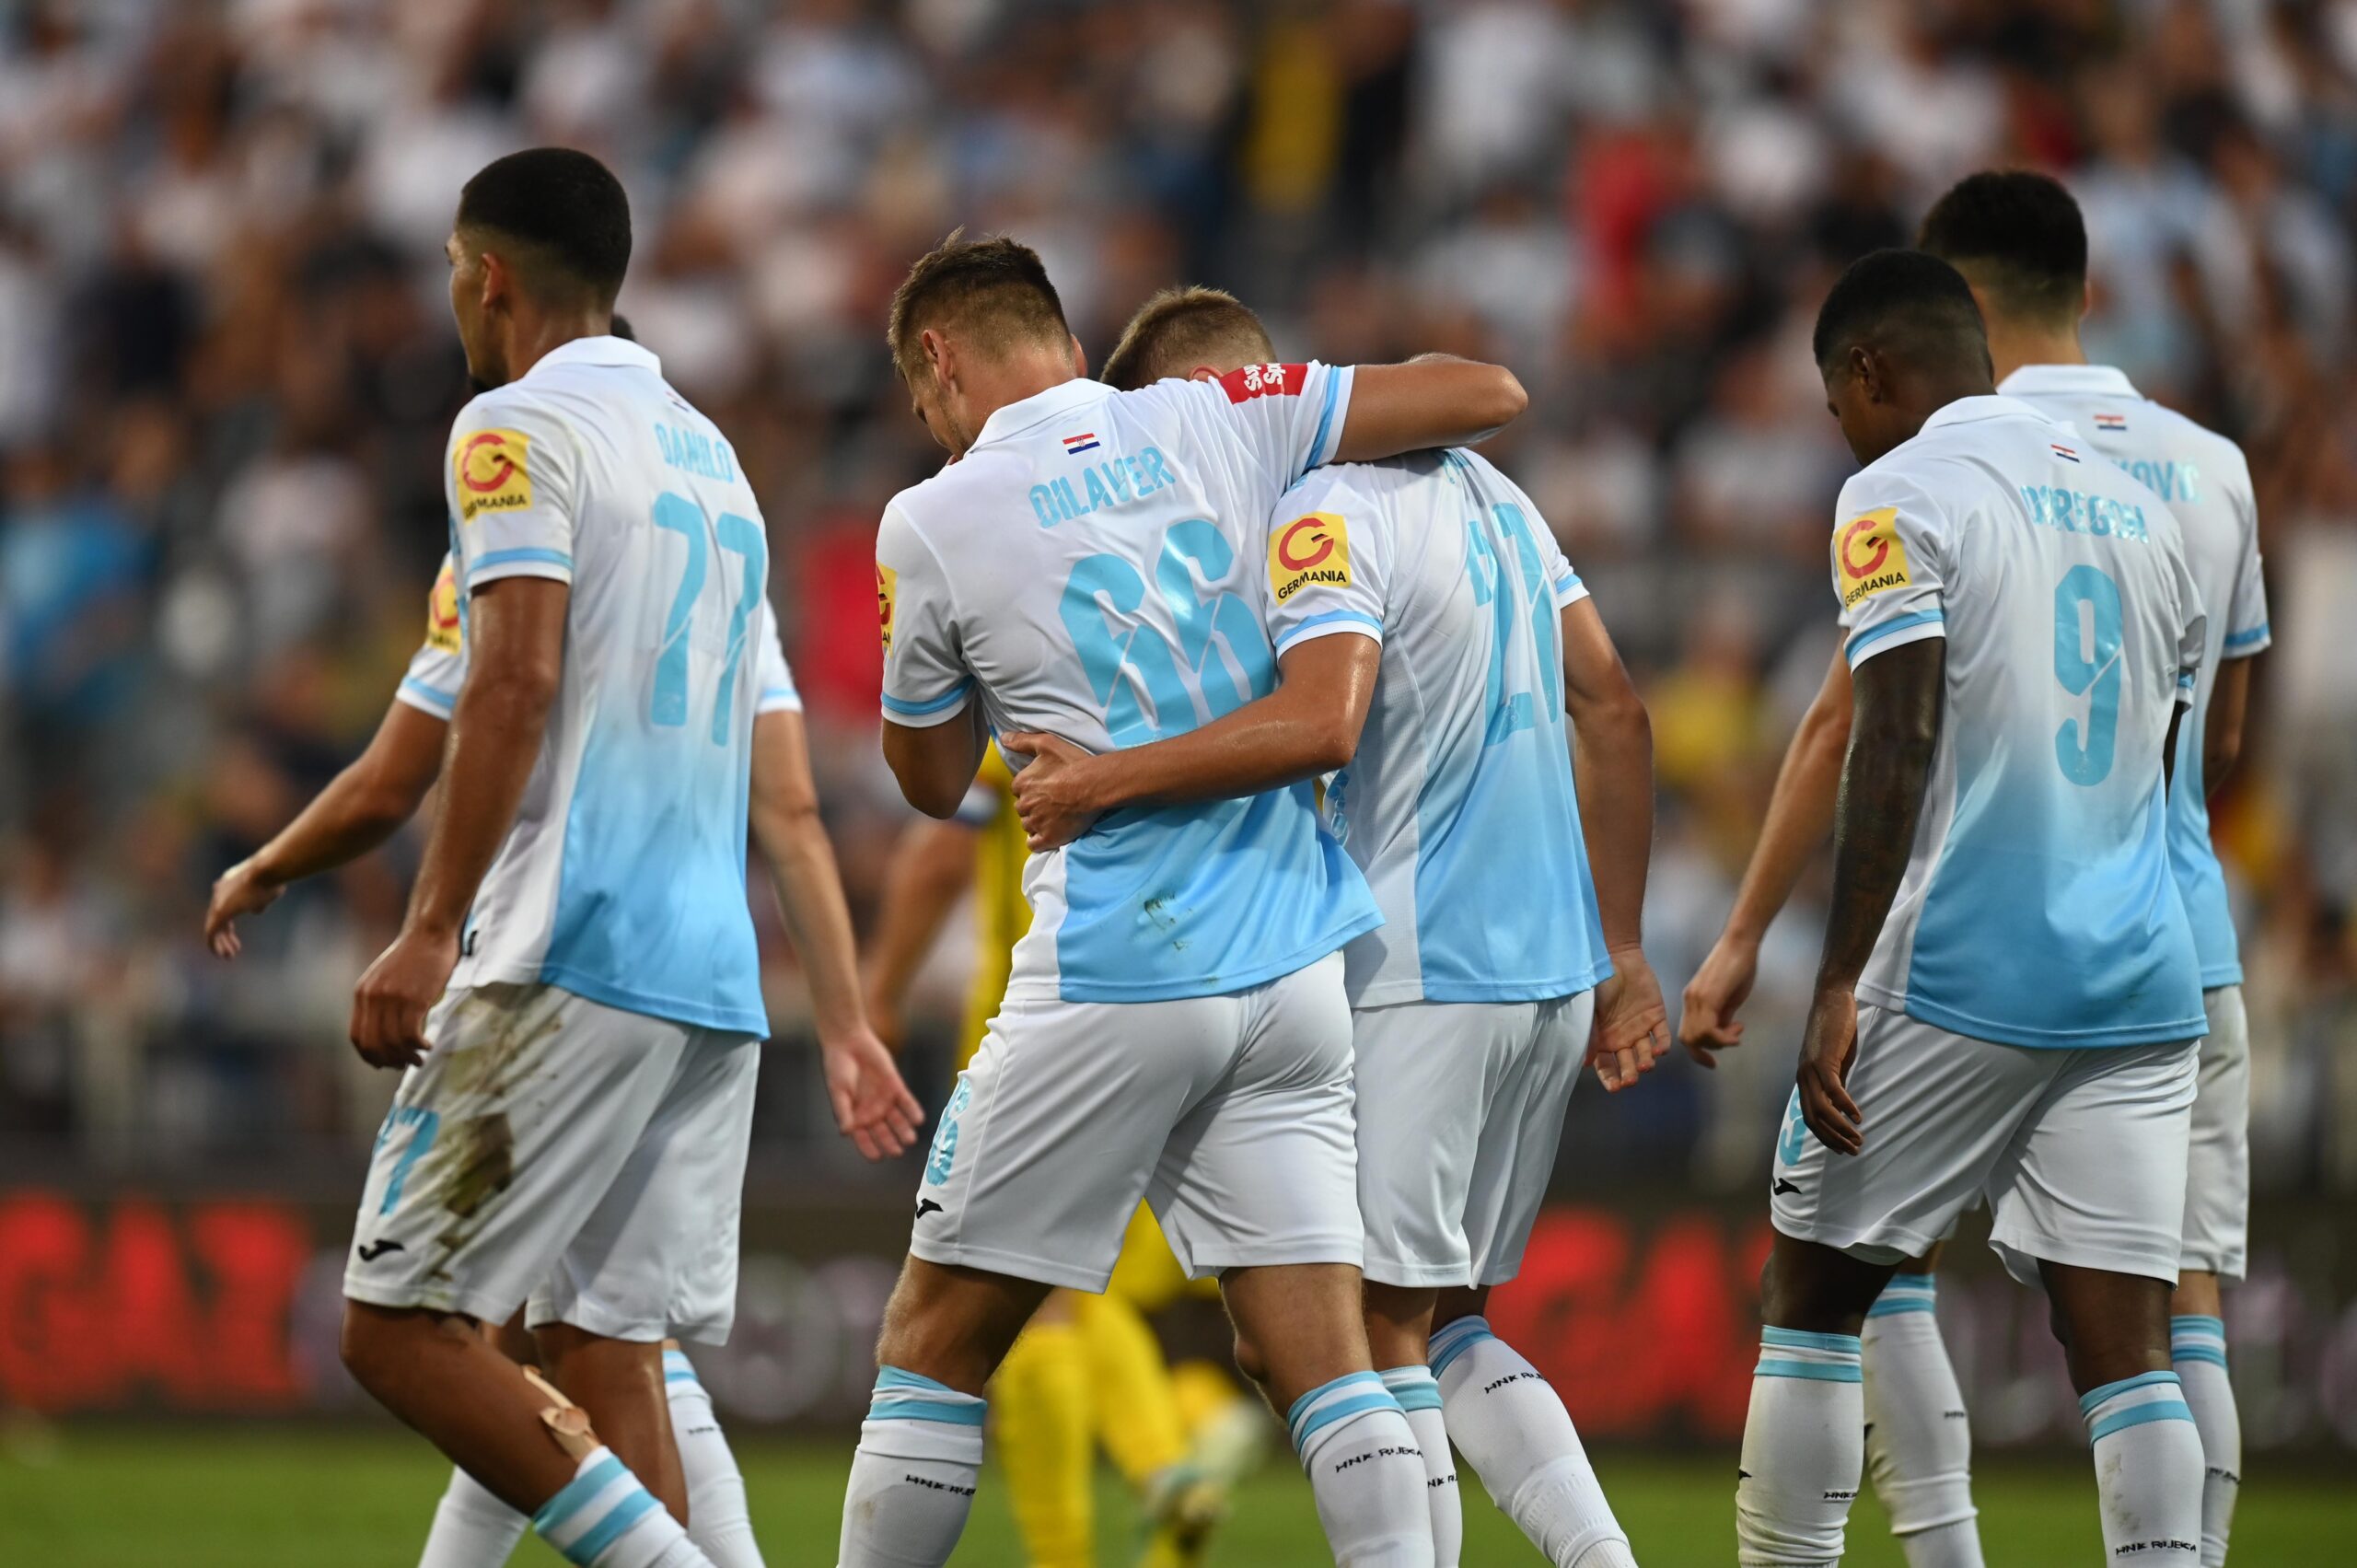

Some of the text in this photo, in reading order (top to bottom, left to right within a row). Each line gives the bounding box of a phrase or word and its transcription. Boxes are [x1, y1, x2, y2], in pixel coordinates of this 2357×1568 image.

[1028, 447, 1176, 528] DILAVER
[1278, 570, 1346, 598] GERMANIA
[1844, 572, 1905, 608] GERMANIA
[653, 492, 766, 748] 77
[1058, 518, 1275, 749] 66
[2054, 564, 2122, 787] 9
[1484, 1375, 1518, 1394] HNK
[1336, 1453, 1375, 1473] HNK
[906, 1474, 945, 1489] HNK
[2116, 1539, 2197, 1556] HNK RIJEKA
